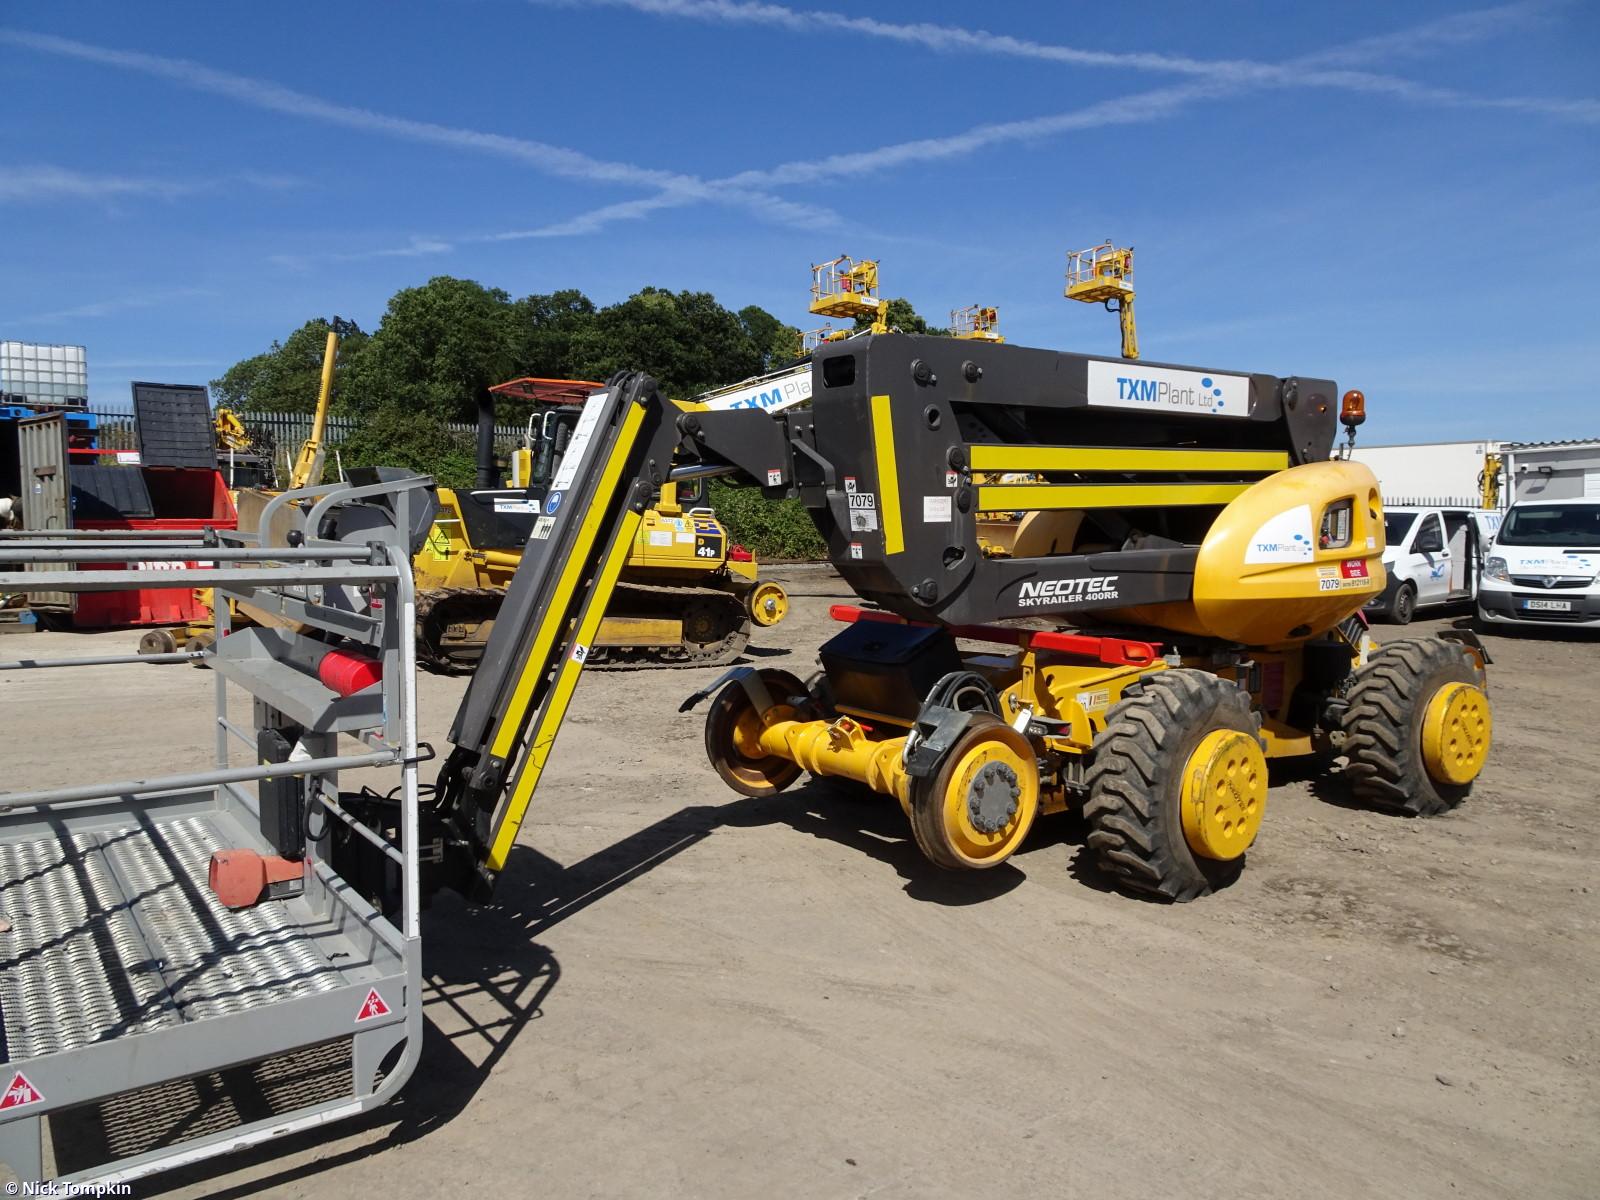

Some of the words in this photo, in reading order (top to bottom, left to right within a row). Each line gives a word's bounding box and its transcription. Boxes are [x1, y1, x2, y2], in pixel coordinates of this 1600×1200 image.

[849, 494, 874, 507] 7079
[1018, 576, 1119, 598] NEOTEC
[1321, 578, 1340, 589] 7079
[1018, 594, 1083, 607] SKYRAILER
[1085, 591, 1119, 601] 400RR
